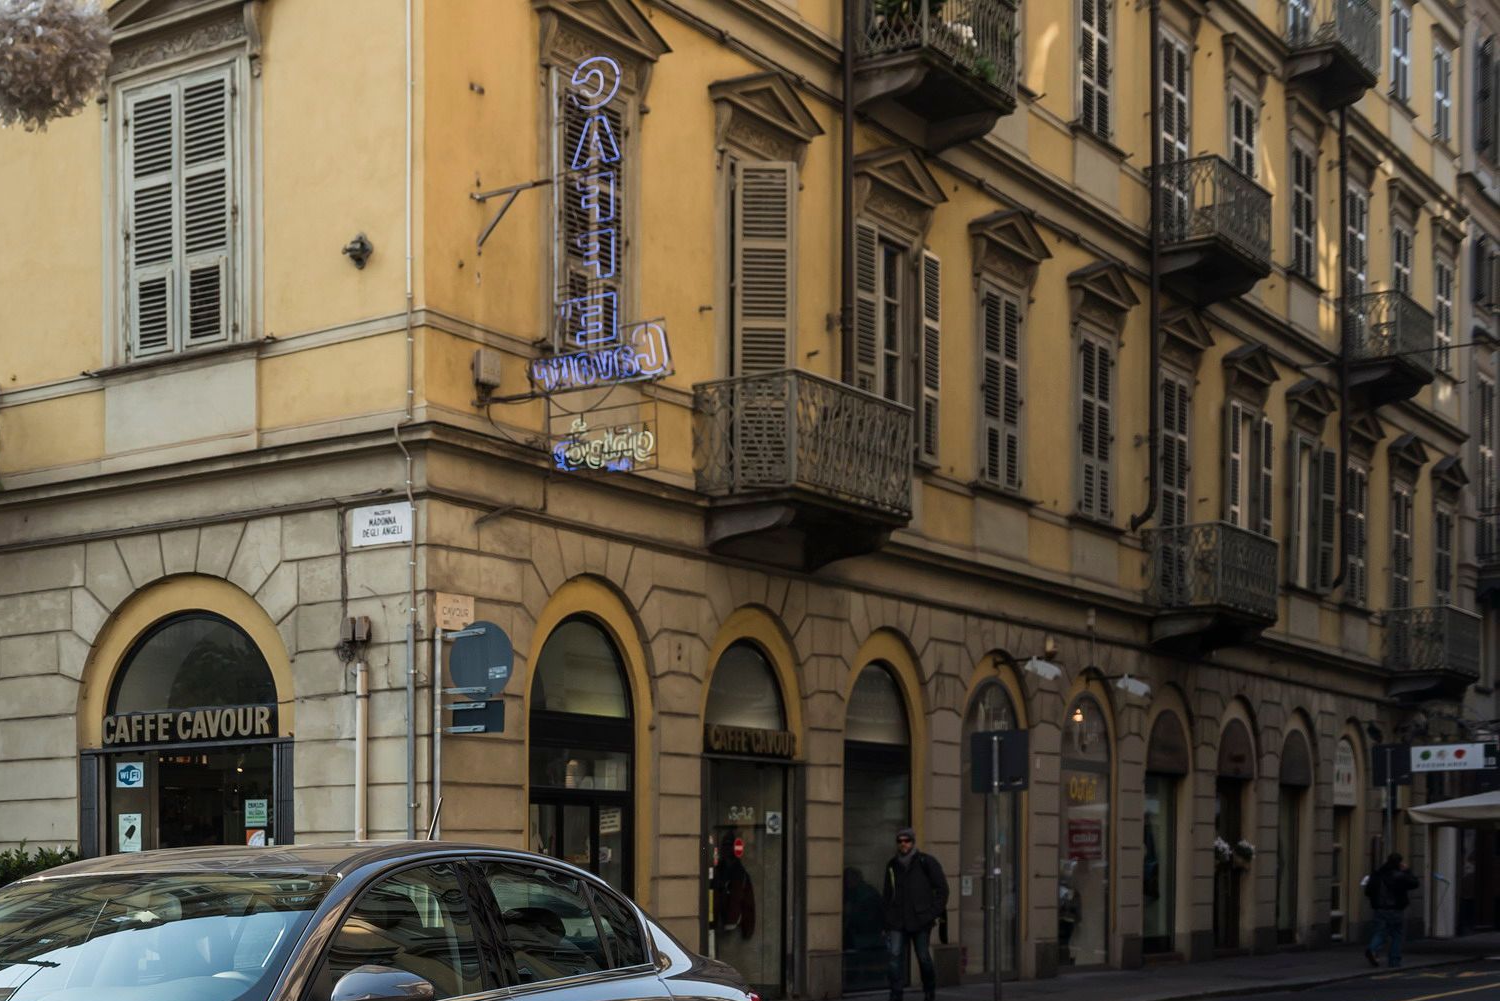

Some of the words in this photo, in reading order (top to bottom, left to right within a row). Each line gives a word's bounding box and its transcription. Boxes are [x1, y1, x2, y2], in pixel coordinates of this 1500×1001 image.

[369, 516, 397, 526] MADONNA
[362, 528, 380, 538] DEGLI
[382, 525, 403, 536] ANGELI
[442, 606, 469, 617] CAVOUR
[176, 706, 271, 741] CAVOUR
